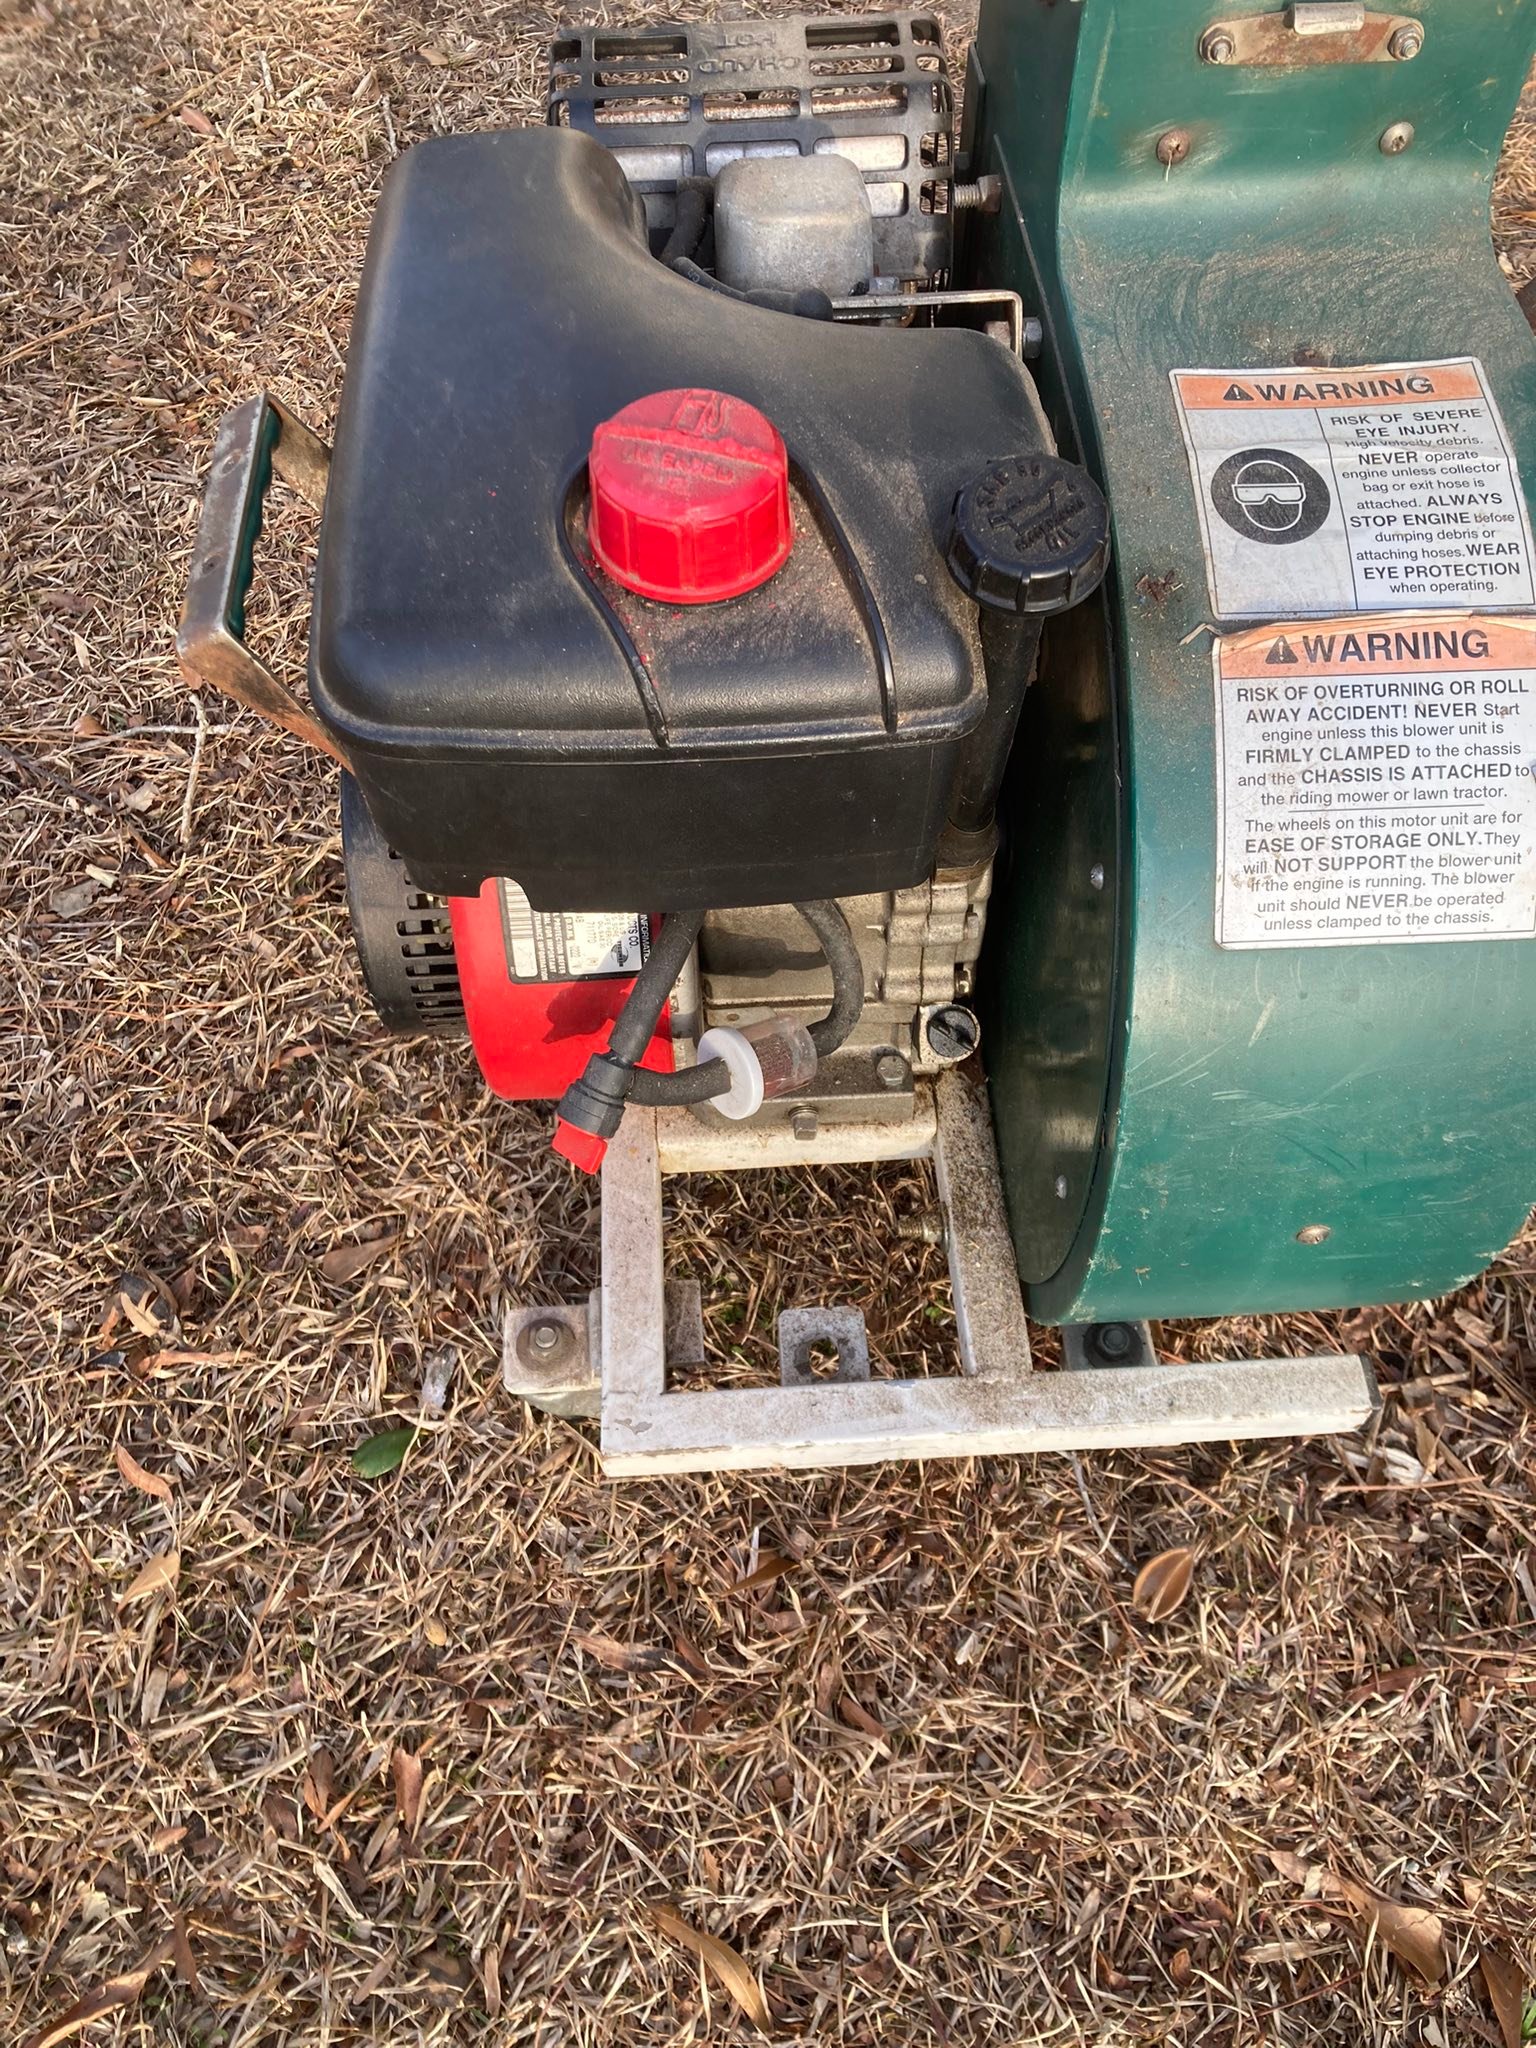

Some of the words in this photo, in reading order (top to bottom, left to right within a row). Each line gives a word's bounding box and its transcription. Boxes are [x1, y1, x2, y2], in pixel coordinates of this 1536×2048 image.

[1255, 376, 1435, 401] WARNING
[1331, 415, 1371, 426] RISK
[1380, 413, 1403, 423] OF
[1414, 409, 1483, 421] SEVERE
[1356, 427, 1390, 438] EYE
[1399, 423, 1467, 436] INJURY.
[1437, 435, 1484, 446] debris.
[1359, 451, 1419, 465] NEVER
[1425, 450, 1479, 462] operate
[1342, 468, 1388, 479] engine
[1391, 467, 1437, 477] unless
[1441, 462, 1501, 474] collector
[1363, 482, 1389, 494] bag
[1393, 481, 1406, 490] or
[1409, 479, 1434, 490] exit
[1437, 478, 1470, 489] hose
[1474, 477, 1485, 487] is
[1357, 498, 1422, 510] attached.
[1427, 493, 1503, 507] ALWAYS
[1350, 515, 1397, 527] STOP
[1403, 512, 1471, 526] ENGINE
[1474, 511, 1515, 523] before
[1375, 530, 1433, 544] dumping
[1437, 528, 1479, 540] debris
[1483, 529, 1496, 539] or
[1356, 547, 1418, 562] attaching
[1421, 546, 1466, 558] hoses.
[1466, 542, 1520, 556] WEAR
[1363, 567, 1399, 580] EYE
[1404, 562, 1521, 579] PROTECTION
[1390, 581, 1426, 593] when
[1430, 579, 1498, 593] operating.
[1302, 629, 1490, 663] WARNING
[1237, 687, 1279, 702] RISK
[1284, 685, 1308, 700] OF
[1314, 682, 1444, 699] OVERTURNING
[1449, 680, 1476, 695] OR
[1481, 679, 1529, 694] ROLL
[1246, 708, 1301, 723] AWAY
[1308, 705, 1408, 721] ACCIDENT!
[1414, 702, 1477, 718] NEVER
[1484, 702, 1520, 716] Start
[1262, 729, 1313, 743] engine
[1317, 726, 1366, 739] unless
[1370, 724, 1399, 738] this
[1403, 723, 1454, 737] blower
[1459, 721, 1487, 735] unit
[1491, 721, 1504, 734] is
[1246, 748, 1313, 764] FIRMLY
[1319, 745, 1410, 761] CLAMPED
[1416, 744, 1431, 757] to
[1435, 743, 1460, 757] the
[1464, 742, 1521, 756] chassis
[1238, 772, 1266, 786] and
[1271, 771, 1295, 784] the
[1301, 767, 1383, 784] CHASSIS
[1389, 766, 1405, 781] IS
[1411, 763, 1511, 780] ATTACHED
[1515, 764, 1529, 777] to
[1261, 791, 1284, 805] the
[1290, 790, 1332, 807] riding
[1337, 790, 1389, 803] mower
[1393, 789, 1409, 801] or
[1413, 787, 1448, 800] lawn
[1453, 785, 1507, 799] tractor.
[1246, 819, 1274, 832] The
[1278, 817, 1331, 831] wheels
[1335, 817, 1354, 829] on
[1358, 814, 1386, 828] this
[1391, 813, 1436, 827] motor
[1440, 813, 1468, 826] unit
[1472, 813, 1497, 825] are
[1500, 811, 1522, 824] for
[1245, 838, 1294, 854] EASE
[1300, 837, 1326, 851] OF
[1331, 834, 1421, 850] STORAGE
[1427, 831, 1482, 847] ONLY.
[1484, 832, 1520, 849] They
[1243, 860, 1268, 874] will
[1274, 858, 1313, 873] NOT
[1319, 854, 1406, 871] SUPPORT
[1410, 855, 1434, 868] the
[1438, 853, 1491, 867] blower
[1494, 853, 1521, 865] unit
[1265, 877, 1288, 891] the
[1293, 876, 1343, 892] engine
[1348, 875, 1360, 889] is
[1365, 874, 1426, 891] running.
[1432, 872, 1459, 885] The
[1463, 871, 1515, 884] blower
[1257, 899, 1286, 912] unit
[1290, 896, 1340, 911] should
[1346, 894, 1408, 909] NEVER
[1413, 894, 1432, 907] be
[1436, 891, 1504, 908] operated
[1264, 916, 1312, 931] unless
[1317, 913, 1382, 930] clamped
[1386, 912, 1401, 926] to
[1406, 912, 1430, 925] the
[1434, 910, 1494, 924] chassis.
